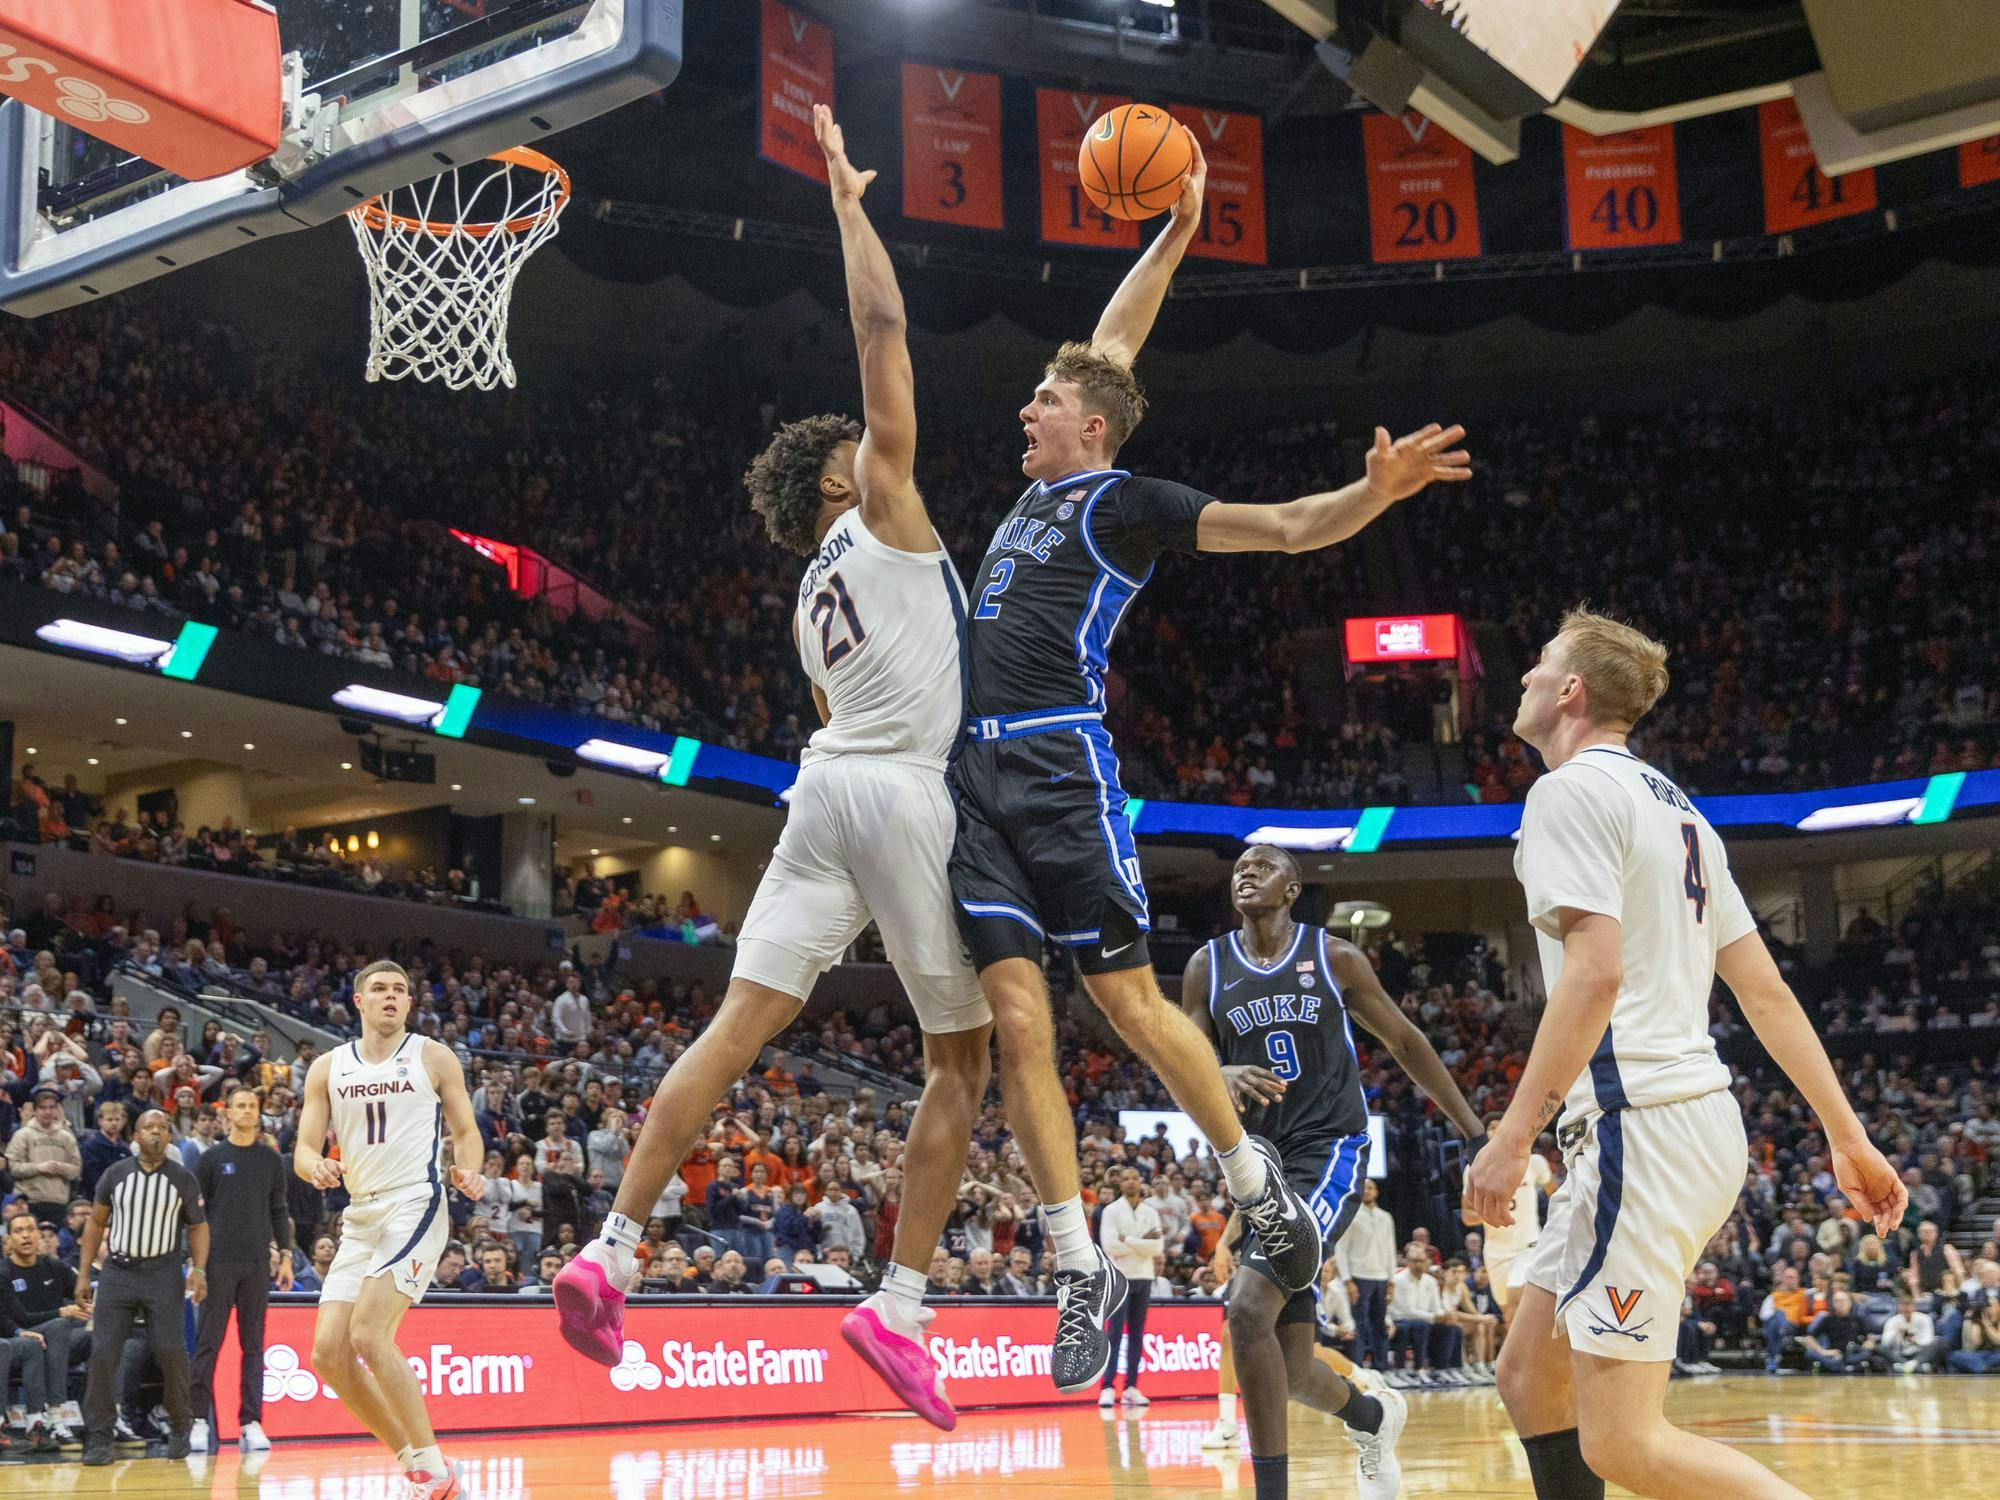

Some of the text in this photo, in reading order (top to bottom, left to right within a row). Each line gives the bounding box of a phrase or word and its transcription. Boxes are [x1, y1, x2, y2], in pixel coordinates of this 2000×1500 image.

[939, 160, 966, 209] 3
[1791, 163, 1846, 211] 41
[1200, 201, 1244, 247] 15
[1392, 198, 1457, 247] 20
[1589, 185, 1658, 234] 40
[986, 516, 1066, 564] DUKE
[973, 558, 1015, 620] 2
[810, 570, 867, 671] 21
[1681, 822, 1707, 925] 4
[1226, 994, 1322, 1036] DUKE
[1264, 1029, 1302, 1082] 9
[337, 1080, 415, 1099] VIRGINIA
[365, 1101, 387, 1146] 11
[1604, 1285, 1644, 1327] V
[1142, 1332, 1222, 1374] StateFa
